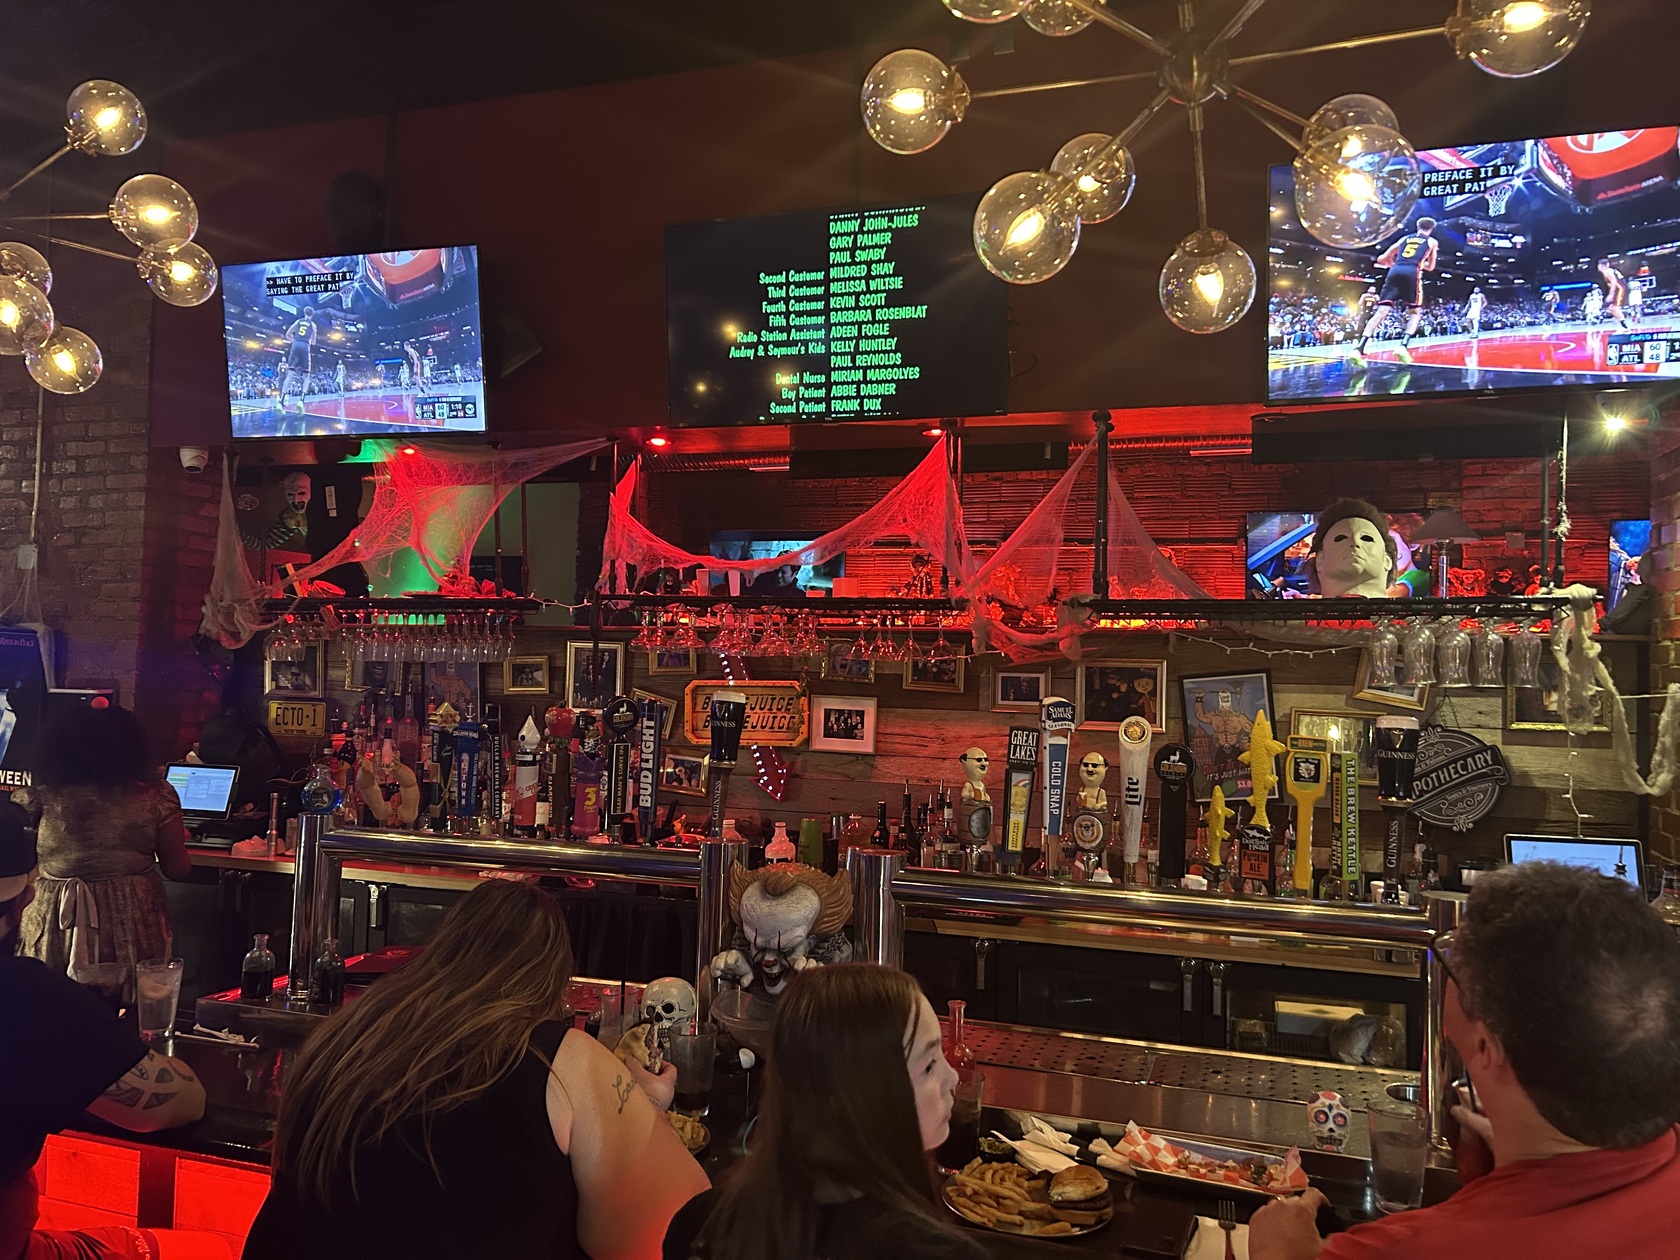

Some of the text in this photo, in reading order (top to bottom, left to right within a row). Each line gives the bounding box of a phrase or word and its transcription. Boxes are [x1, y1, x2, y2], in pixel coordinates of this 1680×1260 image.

[1424, 165, 1515, 183] PREFACE IT BY
[1423, 181, 1487, 196] GREAT PAT
[830, 213, 919, 234] DANNY JOHN-JULES
[829, 232, 892, 249] GARY PALMER
[830, 247, 887, 264] PAUL SWABY
[1402, 244, 1418, 258] 5
[276, 277, 292, 285] HAVE
[306, 273, 332, 283] PREFACE
[759, 261, 896, 284] Second Customer MILDRED SHAY
[266, 286, 288, 295] SAYING
[305, 284, 324, 292] GREAT
[328, 283, 339, 291] PAT
[767, 277, 904, 298] Third Customer MELISSA WILTSIE
[762, 293, 887, 313] Fourth Customer KEVIN SCOTT
[769, 305, 928, 327] Fifth Customer BARBARA ROSENBLAT
[298, 326, 307, 336] 5
[737, 323, 889, 343] Radio Station Assistant ADEEN FOGLE
[729, 337, 897, 360] Audrey & Seymour's Kids KELLY HUNTLEY
[1622, 343, 1661, 352] MIA 60
[831, 352, 901, 368] PAUL REYNOLDS
[1621, 354, 1641, 362] ATL
[775, 367, 920, 385] Dental Nurse MIRIAM MARGOLYES
[782, 383, 896, 401] Boy Patient ABBIE DABNER
[770, 398, 882, 414] Second Patient FRANK DUX
[1048, 705, 1073, 714] SAMUEL
[1050, 712, 1072, 720] ADAMS
[711, 719, 736, 728] UINNESS
[1011, 730, 1039, 747] GREAT
[639, 717, 655, 808] BUD LIGHT
[1009, 746, 1037, 763] LAKES
[1378, 749, 1416, 760] GUINNESS
[1206, 772, 1219, 782] IT'S
[1220, 769, 1237, 779] JUST
[1410, 749, 1494, 796] POTHECARY
[584, 787, 597, 806] 3
[1049, 761, 1062, 815] COLD SNAP
[1125, 776, 1141, 807] Lite
[712, 780, 722, 820] GUINNESS
[1347, 759, 1356, 874] THE BREW KETTLE
[1248, 843, 1269, 851] Head
[1386, 820, 1399, 868] GUINNESS
[1249, 862, 1261, 873] ALE
